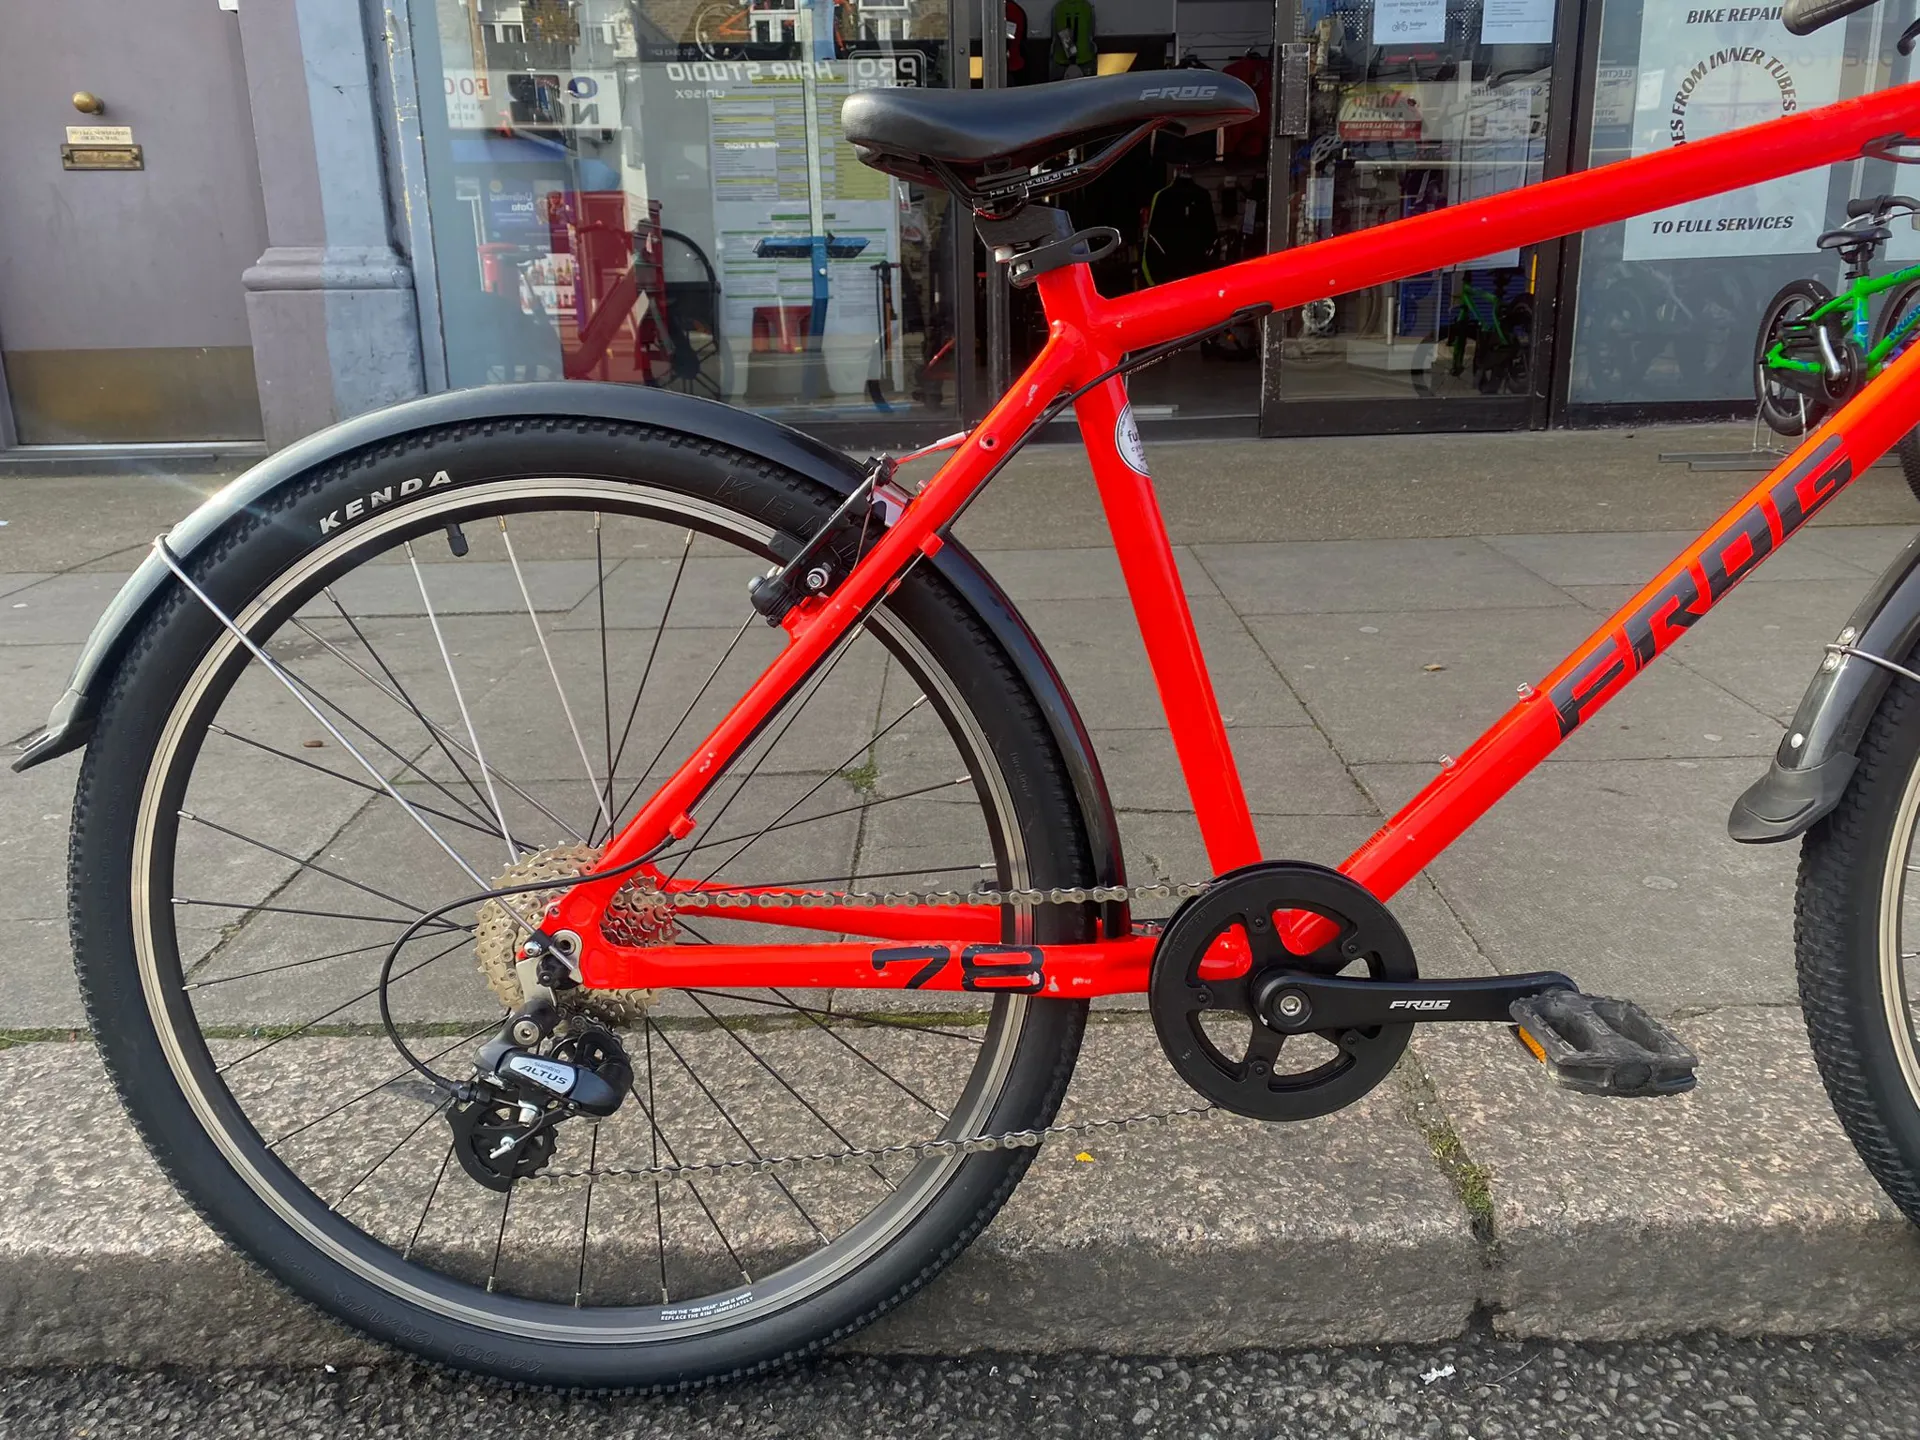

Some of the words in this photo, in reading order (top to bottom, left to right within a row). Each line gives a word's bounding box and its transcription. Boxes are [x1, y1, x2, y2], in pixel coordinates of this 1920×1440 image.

[1686, 10, 1724, 24] BIKE
[1727, 6, 1783, 22] REPAI
[1671, 61, 1708, 116] FROM
[1709, 46, 1765, 69] INNER
[1764, 55, 1797, 112] TUBES
[1139, 85, 1219, 101] FROG
[1652, 221, 1673, 235] TO
[1676, 219, 1713, 234] FULL
[1715, 215, 1795, 232] SERVICES
[319, 470, 452, 535] KENDA
[1548, 432, 1854, 741] FROG
[871, 944, 1046, 994] 78
[1389, 1000, 1451, 1010] FROG
[519, 1065, 568, 1085] ALTUS
[714, 1296, 754, 1315] IMMEDIATELY
